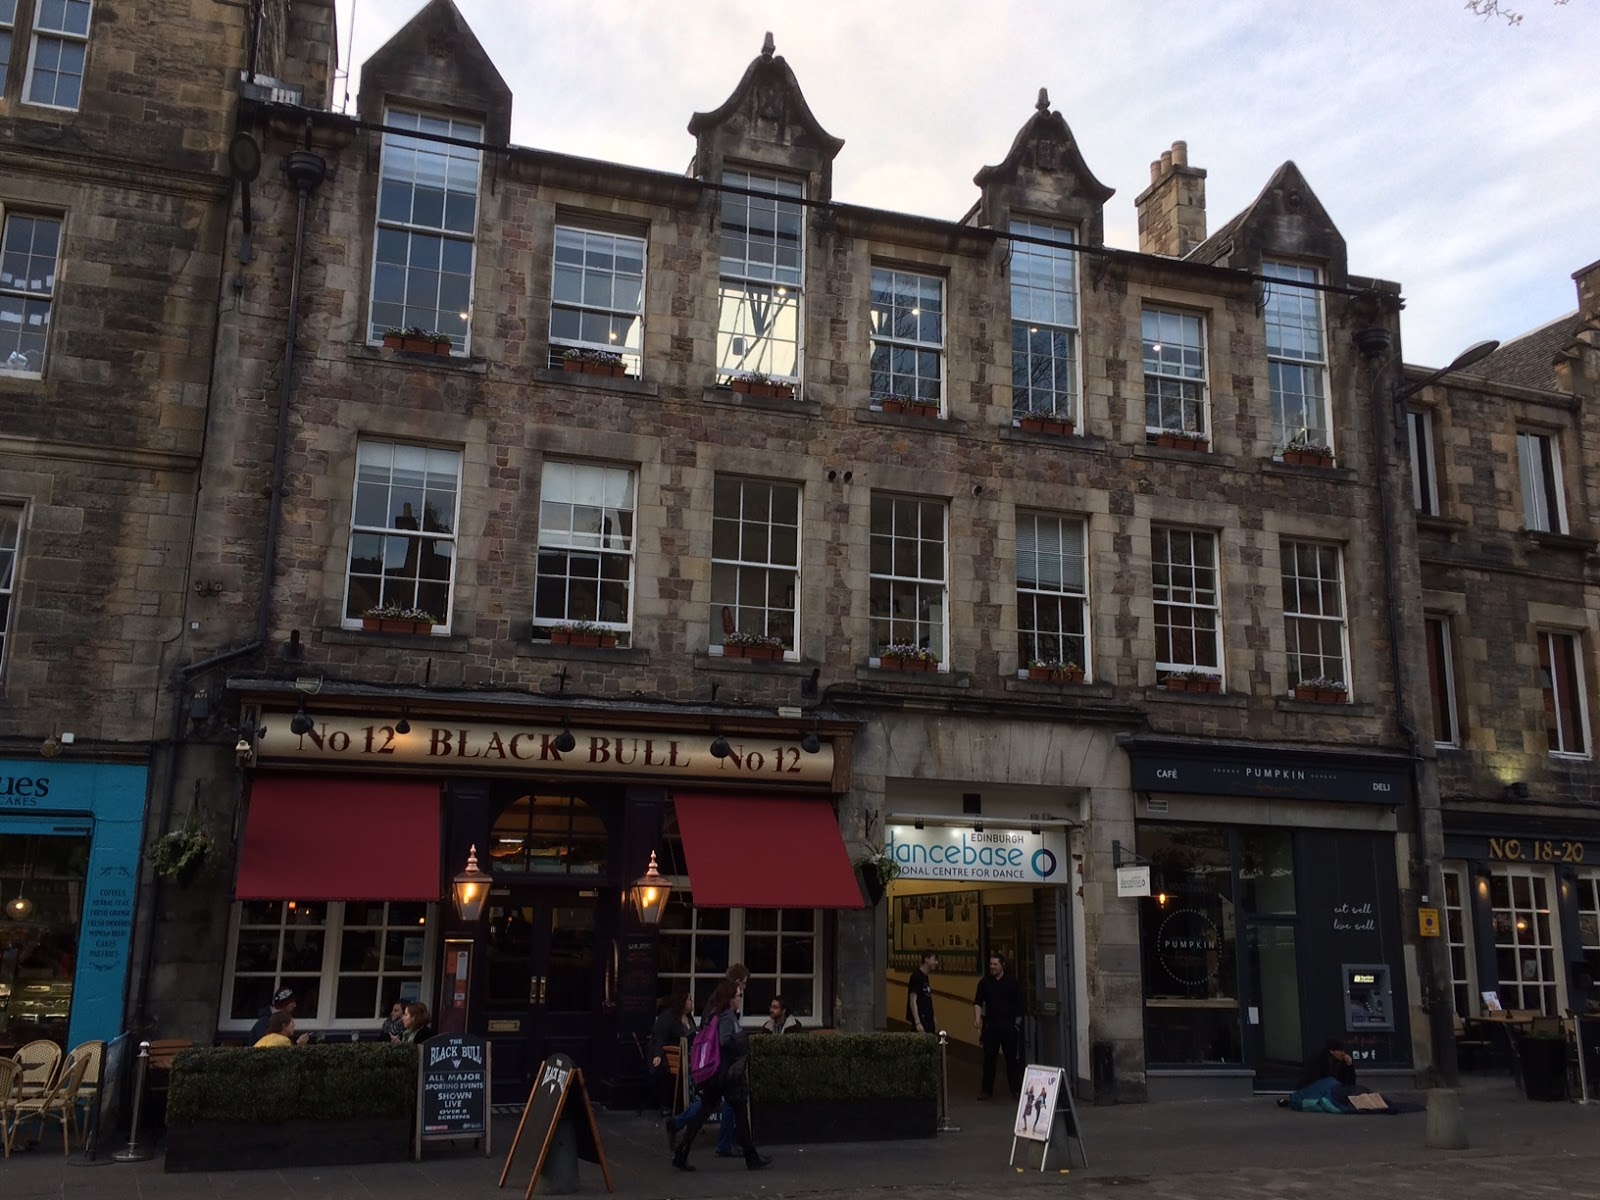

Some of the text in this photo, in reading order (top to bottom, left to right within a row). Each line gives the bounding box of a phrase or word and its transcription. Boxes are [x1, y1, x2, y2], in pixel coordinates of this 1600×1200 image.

[361, 726, 396, 754] 12
[429, 728, 563, 762] BLACK
[587, 735, 691, 768] BULL
[774, 746, 802, 773] 12
[1156, 768, 1391, 792] CAFÉ PUMPKIN DELI
[971, 833, 1024, 844] EDINBURGH
[1488, 838, 1584, 863] NO. 18-20
[932, 867, 969, 877] CENTRE
[971, 868, 990, 878] FOR
[992, 868, 1024, 879] DANCE
[1165, 940, 1216, 949] PUMPKIN
[430, 1045, 482, 1067] BLACK BULL
[447, 1073, 481, 1082] MAJOR
[425, 1083, 459, 1091] SPORTING
[437, 1092, 473, 1101] SHOWN
[444, 1100, 462, 1108] LIVE
